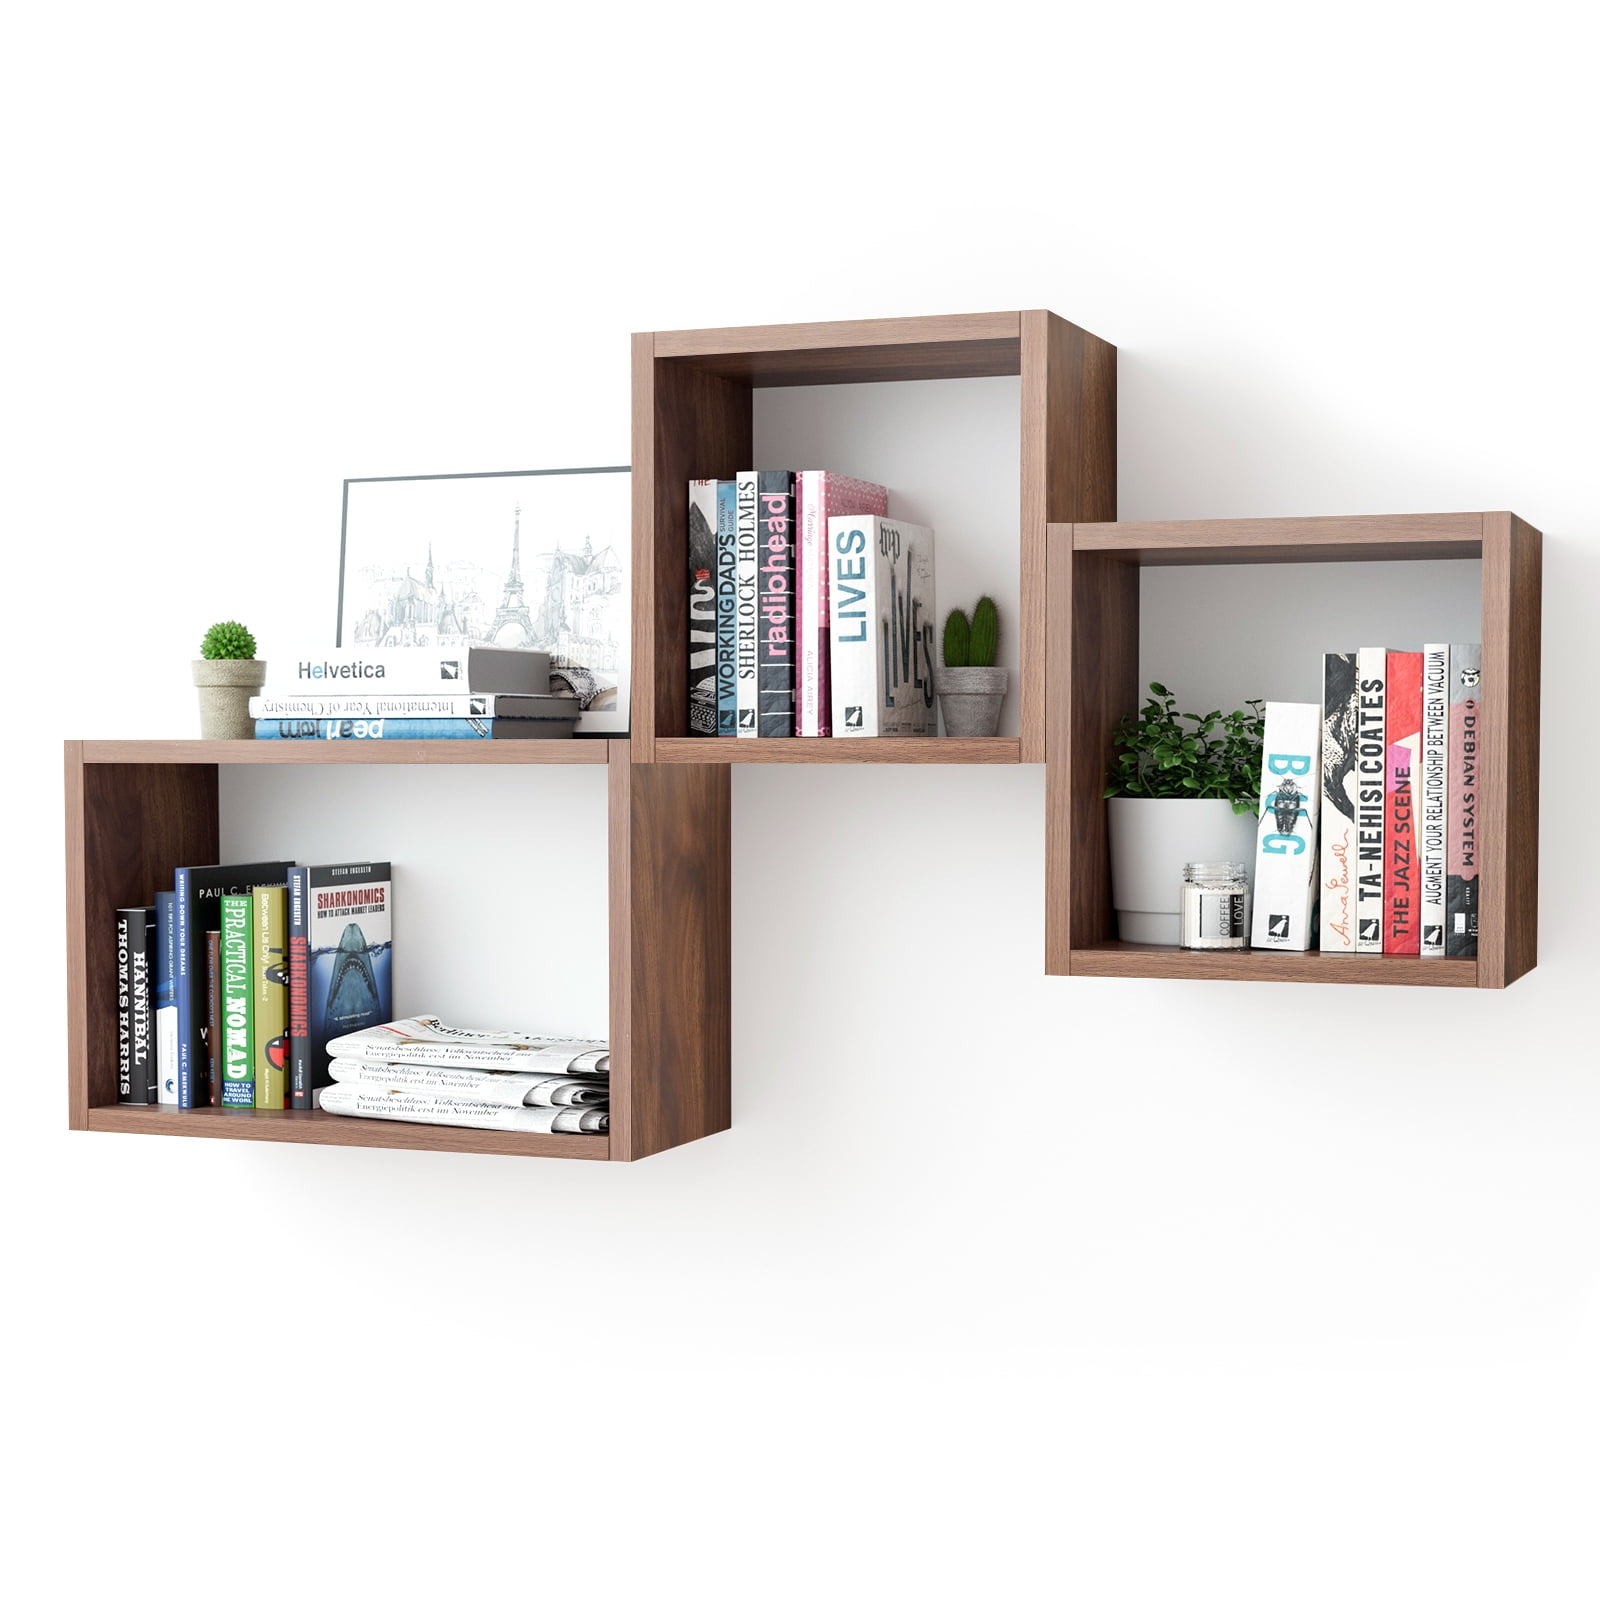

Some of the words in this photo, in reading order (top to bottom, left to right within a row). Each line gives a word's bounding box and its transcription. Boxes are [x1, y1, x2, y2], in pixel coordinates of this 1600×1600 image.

[738, 481, 756, 562] HOLMES
[804, 503, 817, 547] Marriage
[718, 533, 736, 595] DAD'S
[762, 495, 787, 657] radiohead
[836, 529, 867, 643] LIVES
[719, 598, 735, 700] WORKING
[738, 574, 755, 679] SHERLOCK
[298, 660, 386, 680] Helvetica
[1428, 651, 1445, 695] VACUUM
[261, 698, 325, 716] Chemistry
[279, 718, 322, 739] jam
[326, 702, 341, 716] of
[326, 719, 385, 740] pearl
[343, 701, 373, 716] Year
[376, 701, 454, 716] International
[1359, 679, 1384, 774] COATES
[1427, 697, 1444, 746] BETWEEN
[1463, 715, 1476, 787] DEBIAN
[1262, 753, 1311, 856] BUG
[1394, 766, 1411, 834] SCENE
[1425, 751, 1443, 821] RELATIONSHIP
[1359, 780, 1382, 902] TA-NEHISI
[1425, 824, 1443, 853] YOUR
[1462, 792, 1475, 867] SYSTEM
[1394, 839, 1410, 892] JAZZ
[1425, 855, 1442, 905] AUGMENT
[199, 887, 226, 899] PAUL
[223, 900, 248, 908] THE
[317, 887, 385, 910] SHARKONOMICS
[317, 909, 328, 919] HOW
[328, 909, 334, 918] TO
[334, 907, 350, 917] ATTACK
[351, 905, 367, 915] MARKET
[368, 903, 385, 913] LEADERS
[1219, 897, 1230, 936] COFFEE
[1233, 896, 1244, 926] LOVE
[1393, 897, 1409, 938] THE
[1329, 895, 1351, 946] Anna
[118, 919, 129, 1008] THOMAS
[225, 907, 247, 994] PRACTICAL
[133, 951, 147, 1065] HANNIBAL
[290, 936, 307, 1037] SHARKONOMICS
[119, 1011, 130, 1095] HARRIS
[226, 997, 248, 1079] NOMAD
[439, 1079, 481, 1089] November
[451, 1107, 499, 1117] November
